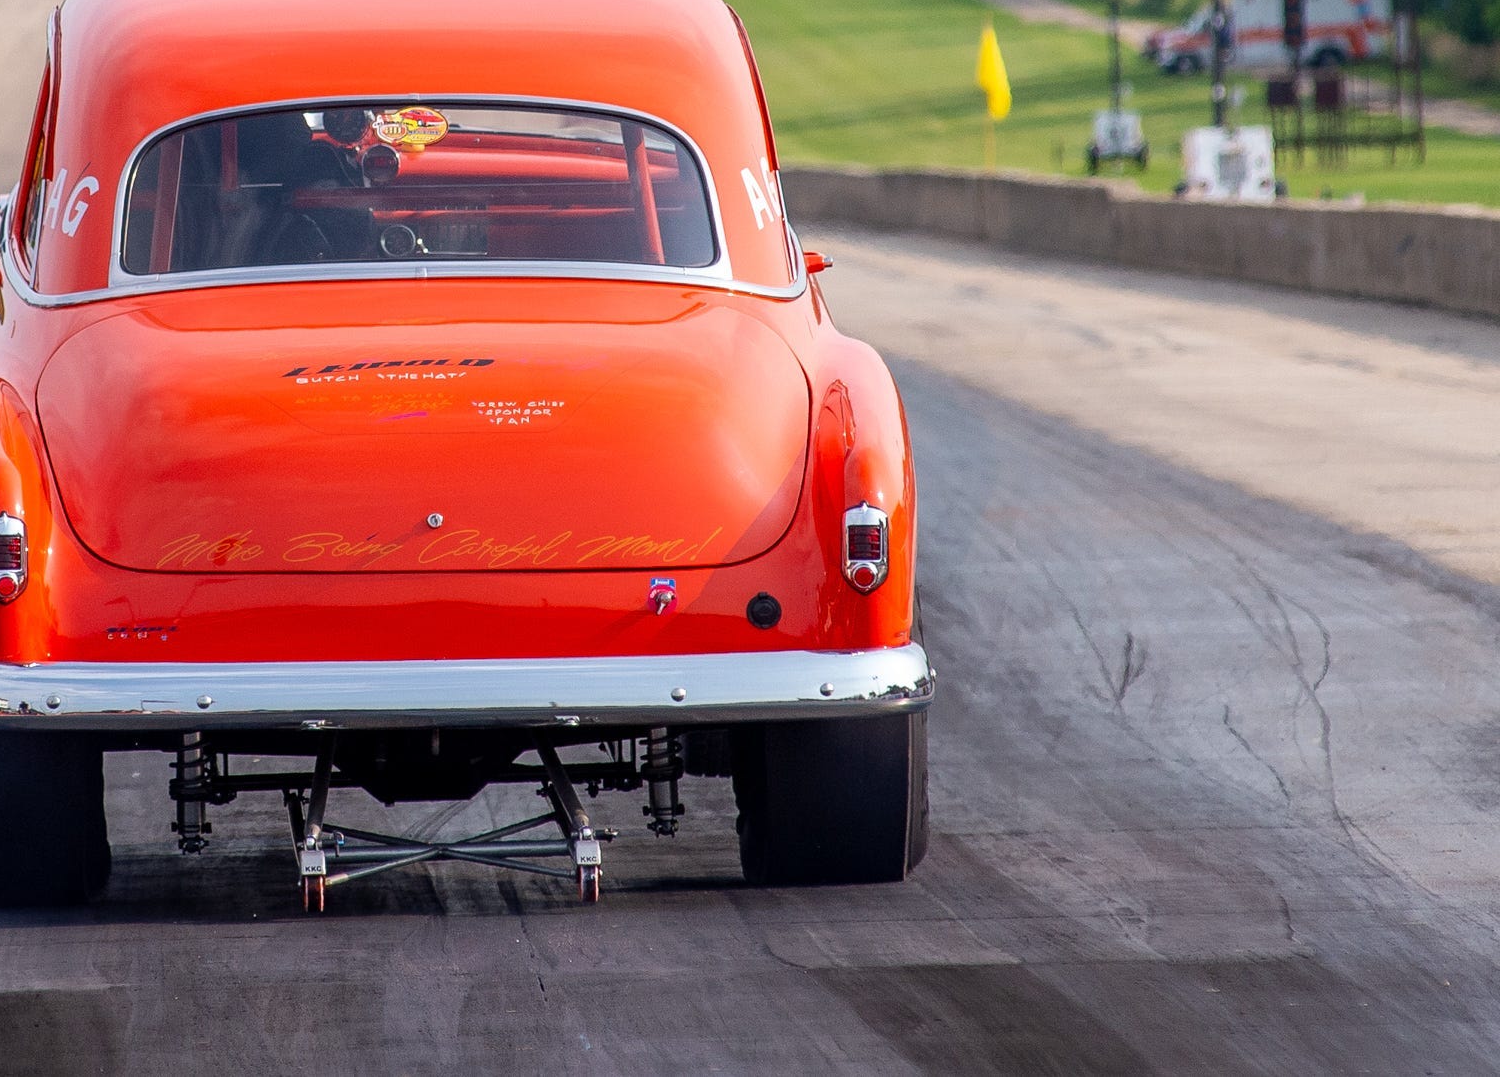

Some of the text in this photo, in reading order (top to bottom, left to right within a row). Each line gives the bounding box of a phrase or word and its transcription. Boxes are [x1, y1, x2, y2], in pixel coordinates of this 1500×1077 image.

[295, 374, 359, 384] BUTCH
[527, 399, 565, 408] CHIEF
[485, 407, 552, 417] SPONSOR
[496, 416, 531, 426] FAN
[282, 531, 403, 570] Being
[417, 529, 573, 569] Careful
